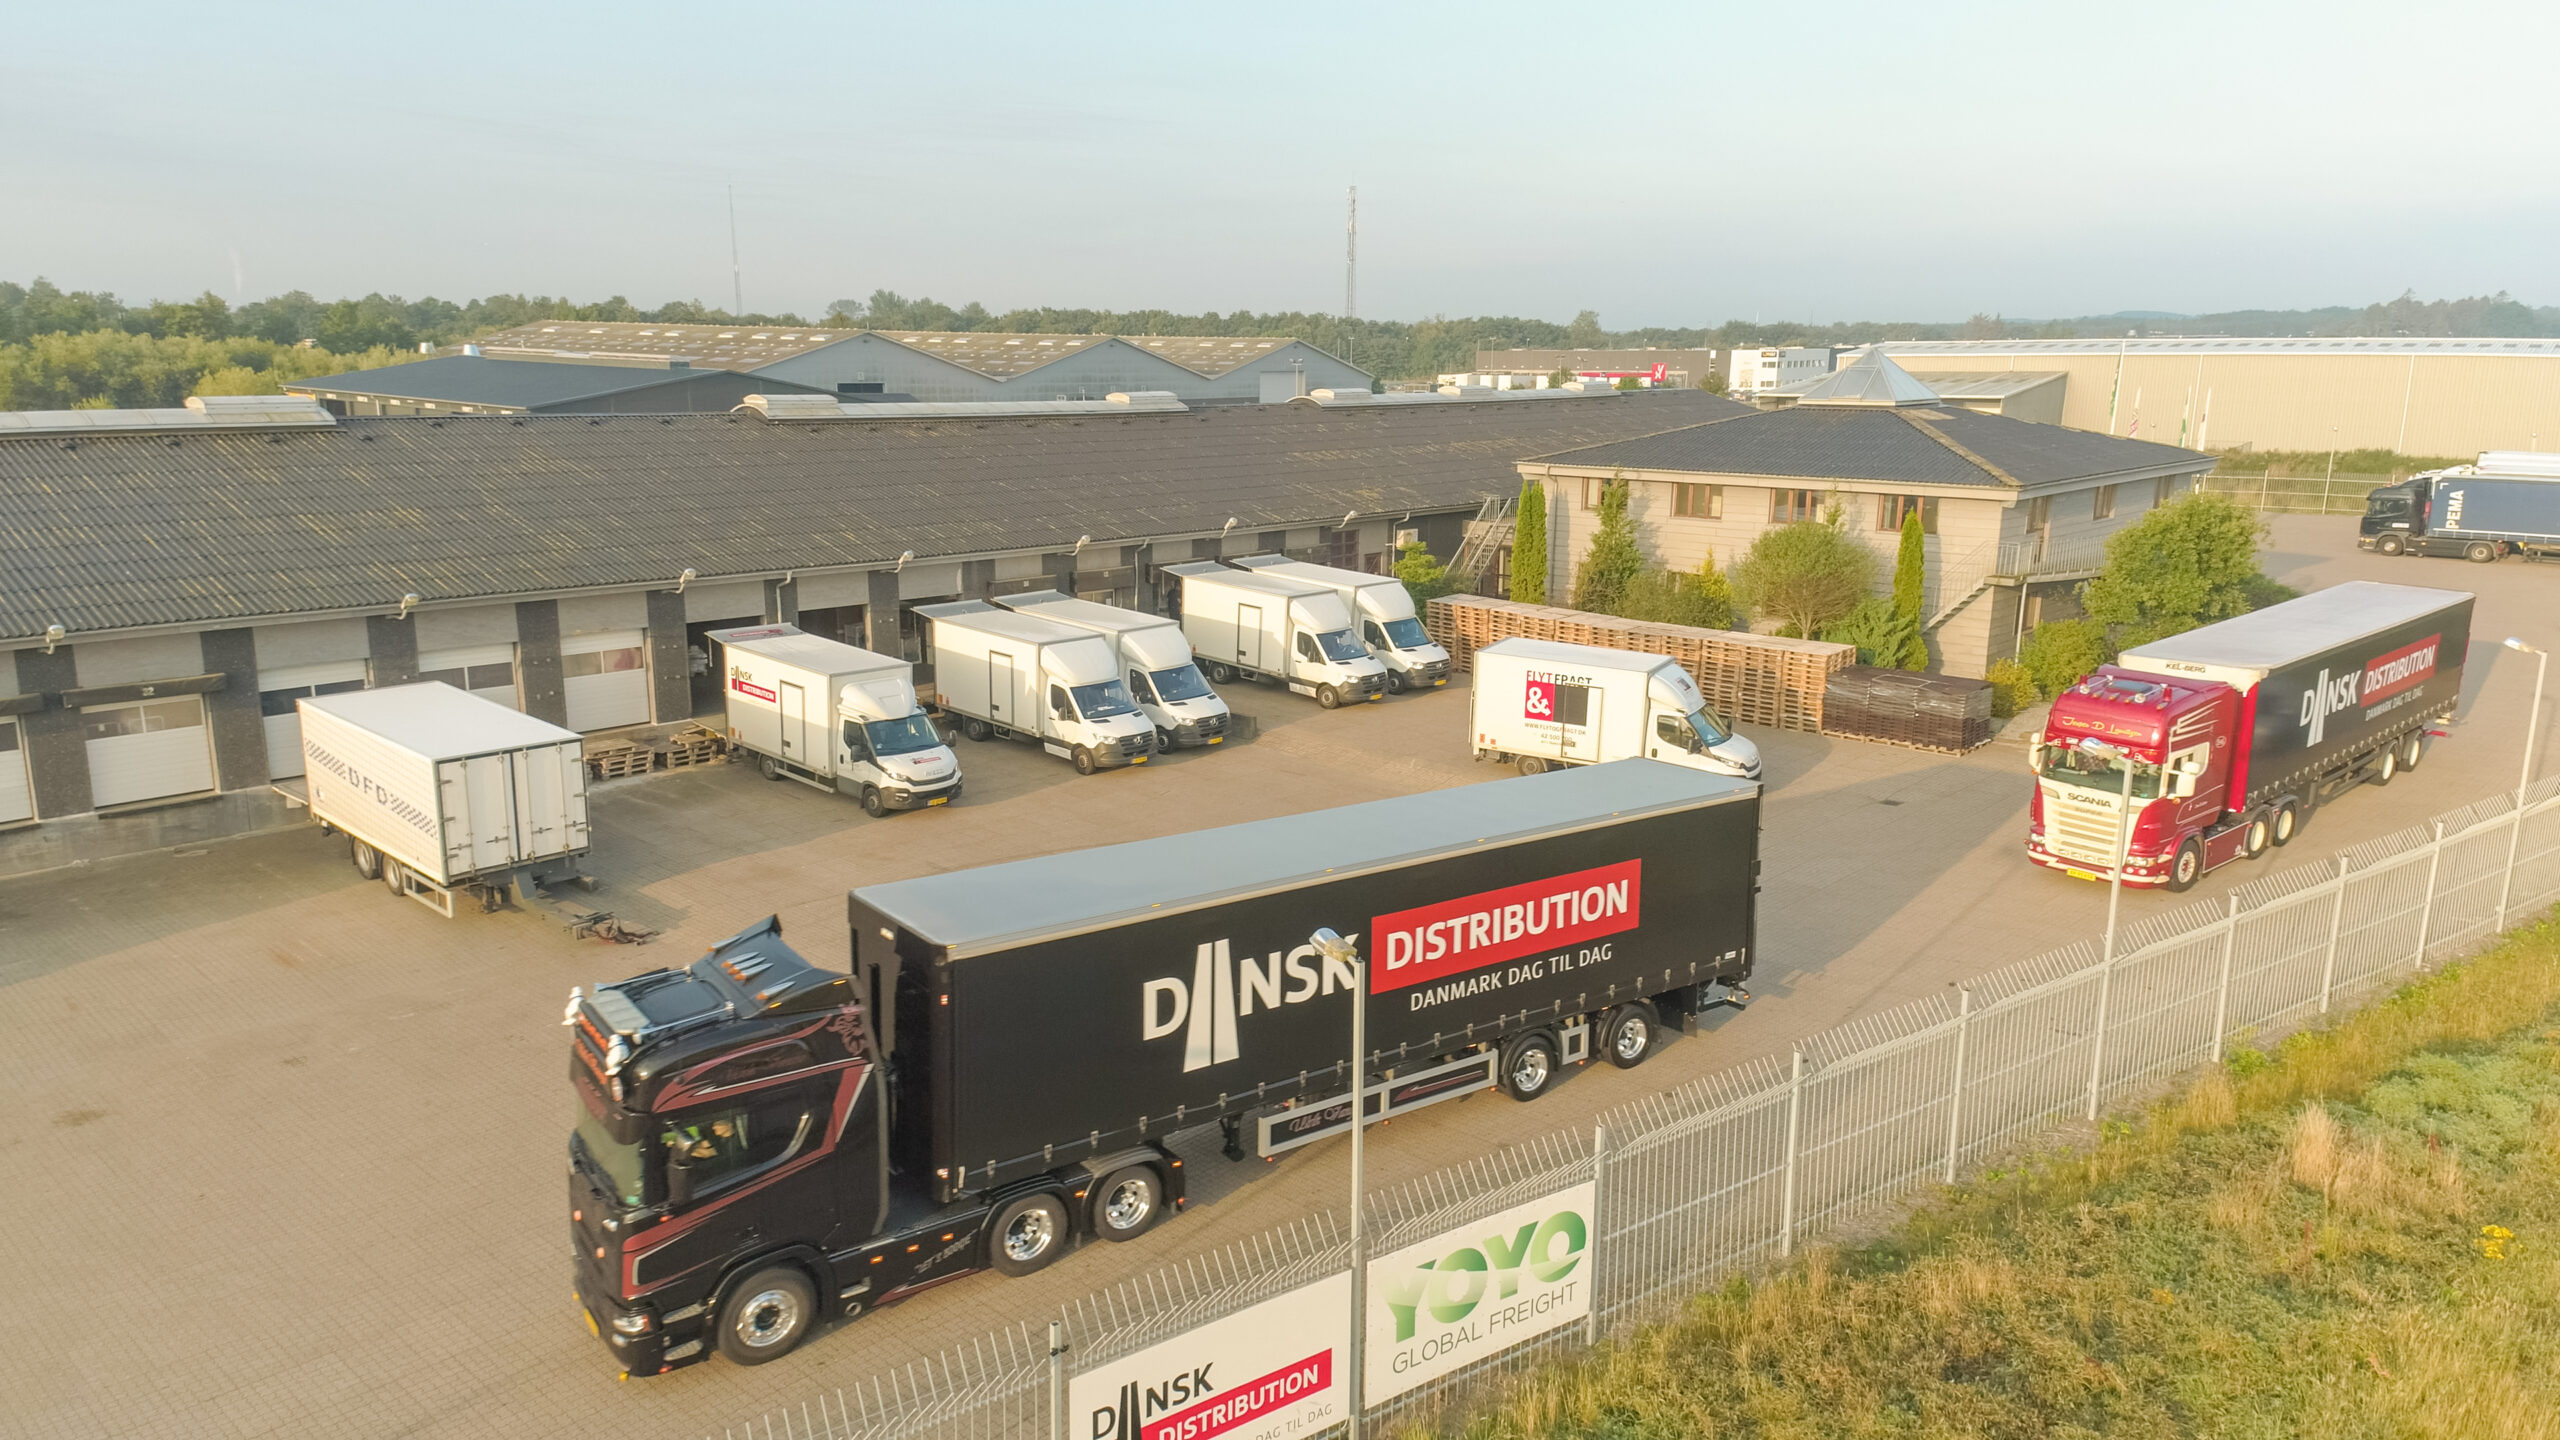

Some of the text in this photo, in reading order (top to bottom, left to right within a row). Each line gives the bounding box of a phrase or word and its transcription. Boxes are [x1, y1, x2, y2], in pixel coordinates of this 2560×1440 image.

[2445, 489, 2465, 529] PEMA
[2363, 644, 2436, 696] DISTRIBUTION
[2067, 792, 2112, 808] SCANIA
[1386, 879, 1629, 971] DISTRIBUTION
[1410, 943, 1613, 1011] DANMARK DAG TIL DAG
[1382, 1211, 1587, 1344] YOYO
[1392, 1281, 1578, 1374] GLOBAL FREIGHT
[1158, 1363, 1319, 1440] DISTRIBUTION
[1285, 1417, 1304, 1433] TIL
[1307, 1403, 1333, 1424] DAG
